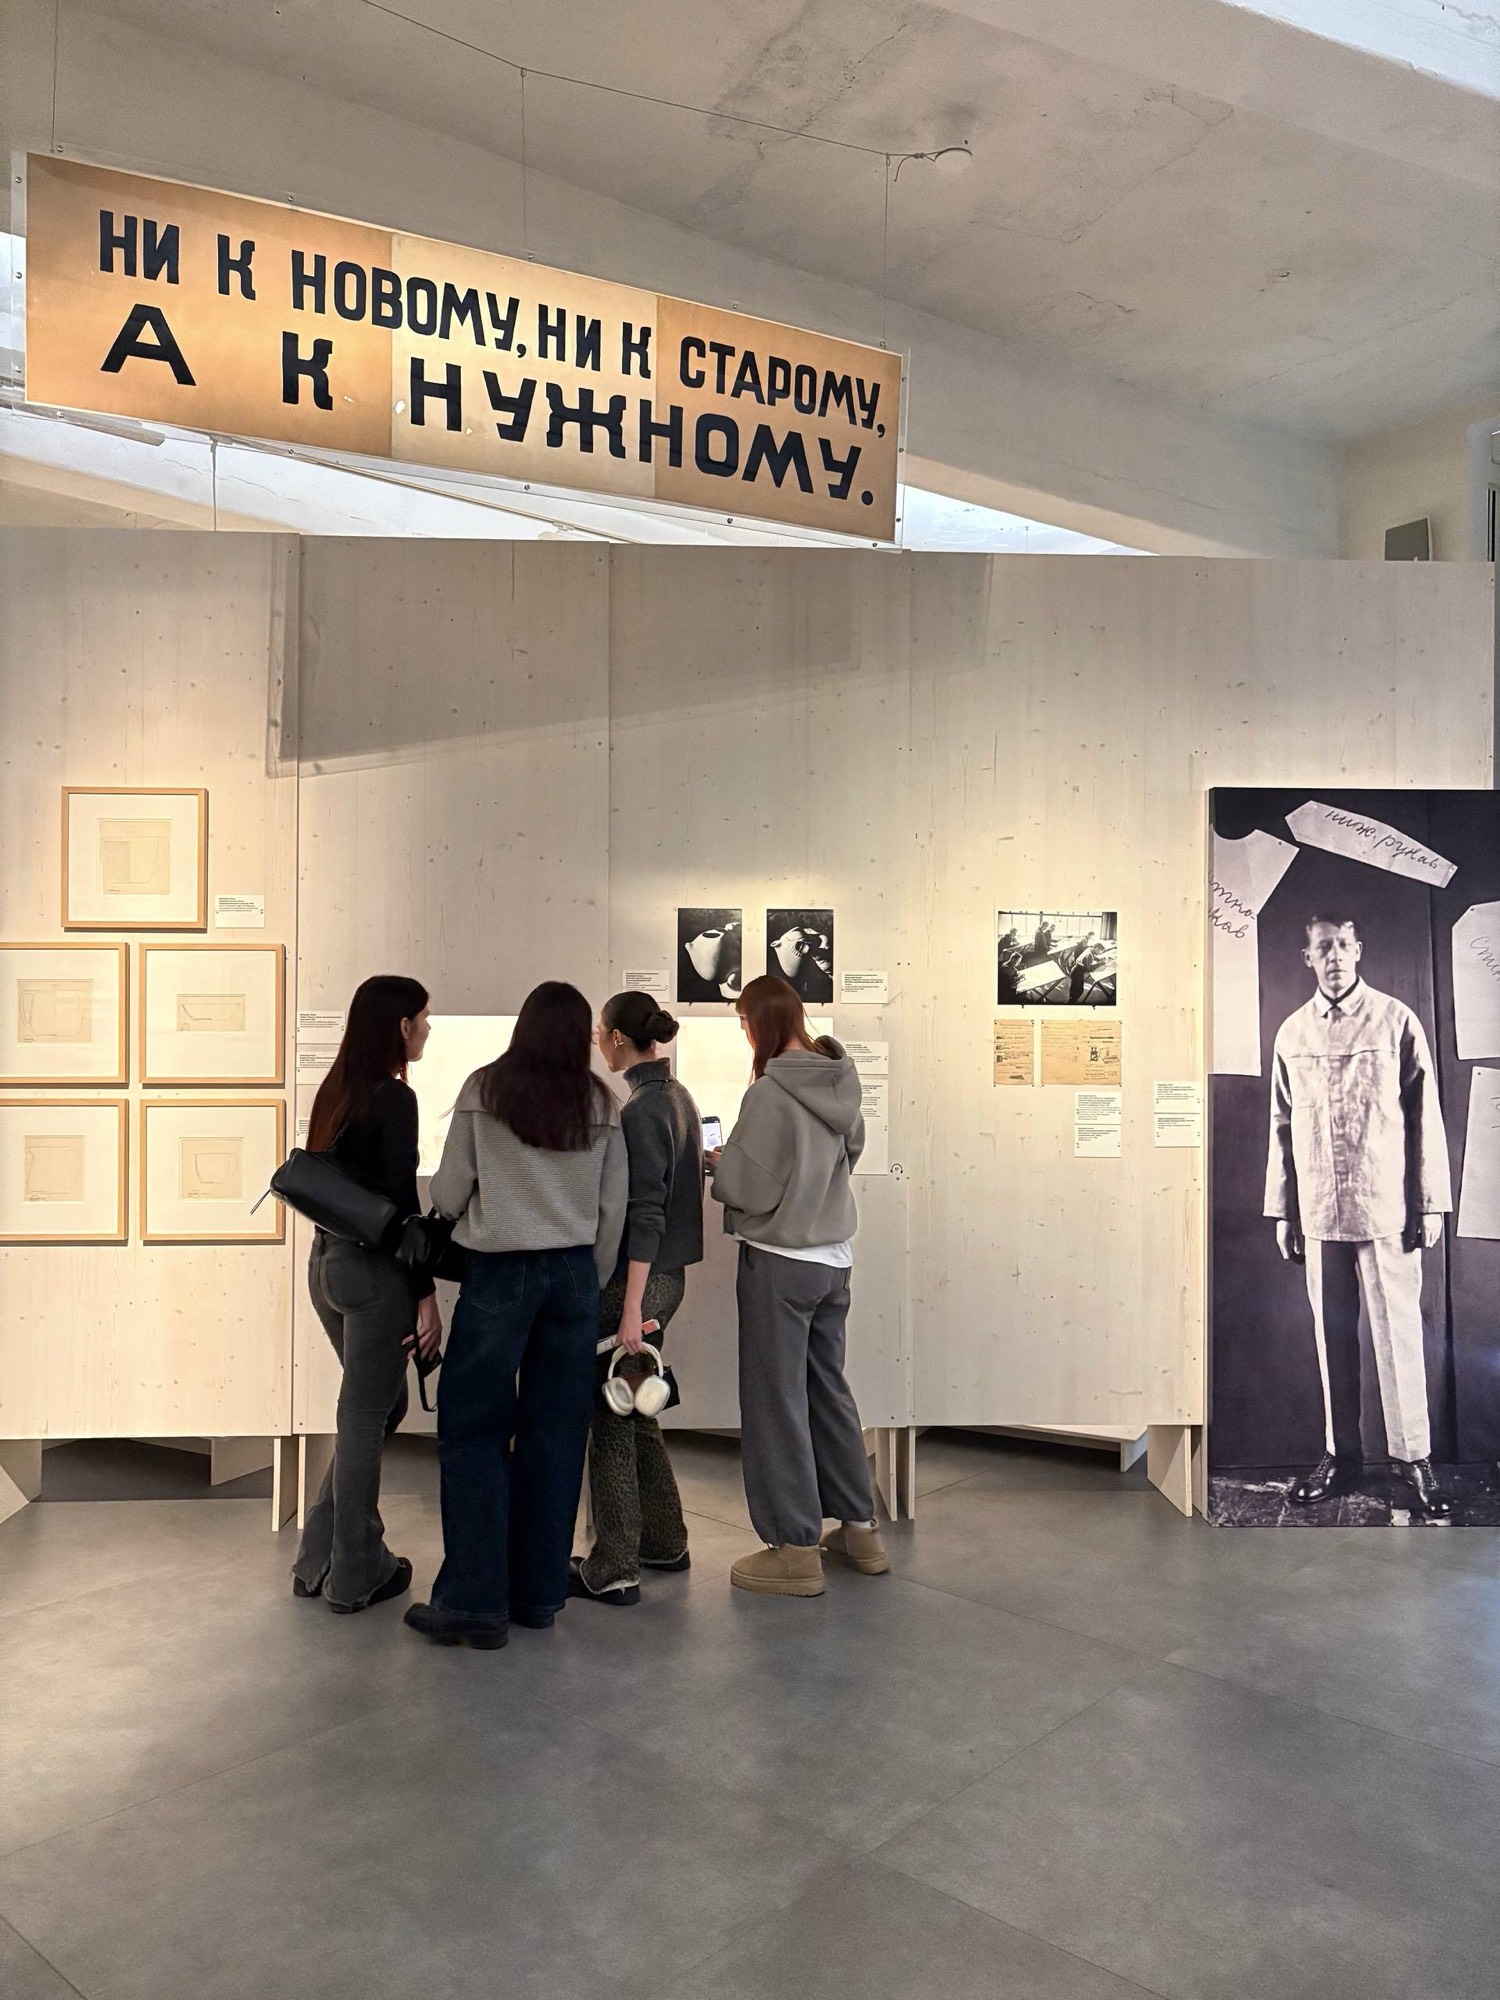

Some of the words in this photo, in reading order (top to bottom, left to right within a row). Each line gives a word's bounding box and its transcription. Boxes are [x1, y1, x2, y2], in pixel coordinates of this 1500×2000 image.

[100, 209, 179, 285] НИ
[217, 233, 256, 301] К
[291, 249, 527, 358] НОВОМУ,
[538, 303, 601, 372] НИ
[621, 321, 652, 380] К
[679, 335, 886, 439] СТАРОМУ,
[101, 303, 197, 386] А
[282, 330, 334, 411] К
[410, 356, 874, 506] НУЖНОМУ.
